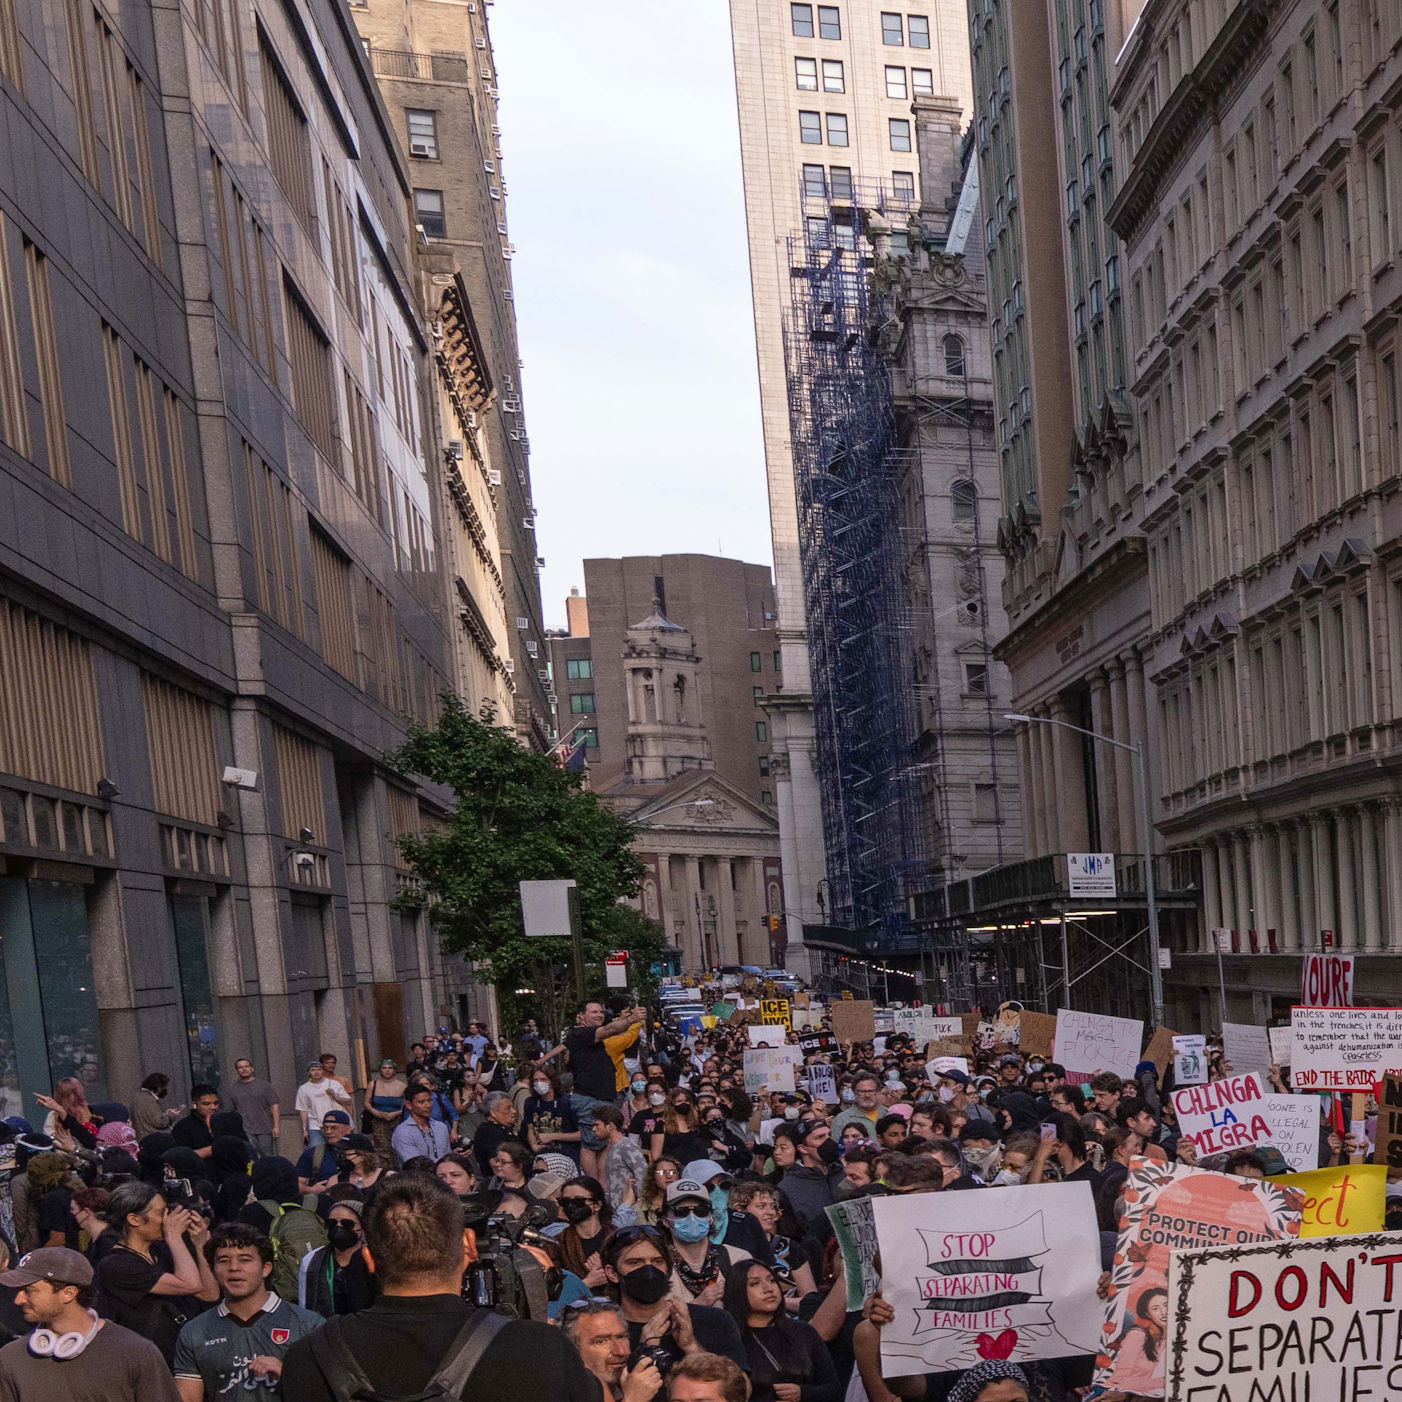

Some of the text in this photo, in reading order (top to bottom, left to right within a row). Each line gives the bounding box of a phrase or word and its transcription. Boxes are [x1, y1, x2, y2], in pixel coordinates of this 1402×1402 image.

[1302, 956, 1351, 1007] YOU'RE
[763, 1000, 788, 1012] ICE
[1293, 1010, 1325, 1019] unless
[1329, 1011, 1346, 1019] one
[1349, 1010, 1367, 1019] lives
[1371, 1011, 1389, 1019] and
[934, 1023, 952, 1034] FUCK
[1063, 1012, 1114, 1032] CHINGA
[800, 1038, 821, 1050] ICE
[1295, 1032, 1305, 1041] to
[1308, 1033, 1346, 1041] remember
[1350, 1032, 1369, 1040] that
[1373, 1032, 1386, 1040] the
[1063, 1041, 1138, 1066] FUCK ICE
[1303, 1043, 1334, 1054] against
[1338, 1043, 1394, 1051] dehumanization
[1295, 1069, 1318, 1086] END
[1320, 1070, 1344, 1085] THE
[1346, 1070, 1377, 1086] RAIDS
[1175, 1075, 1262, 1116] CHINGA
[1210, 1108, 1238, 1127] LA
[1184, 1114, 1273, 1156] MIGRA
[1278, 1130, 1295, 1140] ON
[1149, 1212, 1232, 1241] PROTECT
[940, 1233, 996, 1259] STOP
[923, 1273, 1019, 1298] SEPARATNG
[933, 1308, 1013, 1330] FAMILIES
[205, 1337, 227, 1346] KOTN
